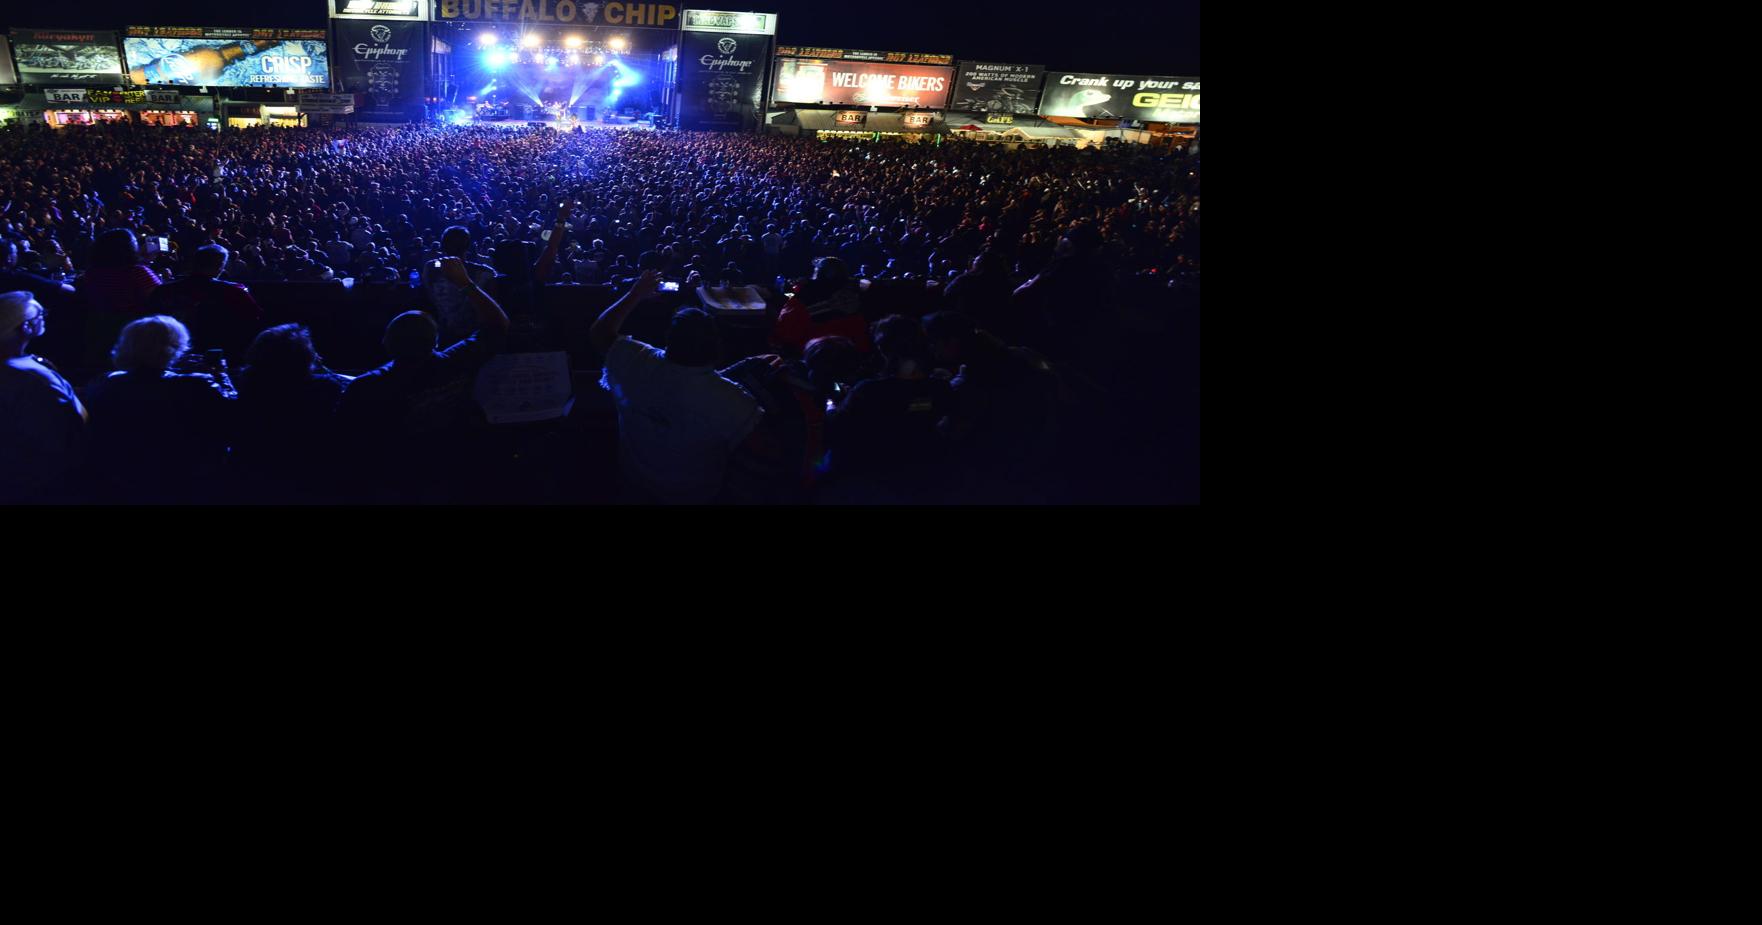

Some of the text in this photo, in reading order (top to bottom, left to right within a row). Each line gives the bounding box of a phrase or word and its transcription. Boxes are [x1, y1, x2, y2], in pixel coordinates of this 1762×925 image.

[442, 0, 676, 26] BUFFALO CHIP
[352, 43, 409, 60] Epiphone
[261, 55, 312, 73] CRISP
[699, 54, 753, 72] Epiphone
[976, 64, 1012, 72] MAGNUM
[832, 71, 945, 92] WELCOME BIKERS
[1060, 75, 1109, 87] Crank
[1112, 79, 1135, 90] up
[1137, 79, 1179, 91] your
[53, 92, 80, 101] BAR
[841, 113, 861, 121] BAR
[909, 115, 929, 124] BAR
